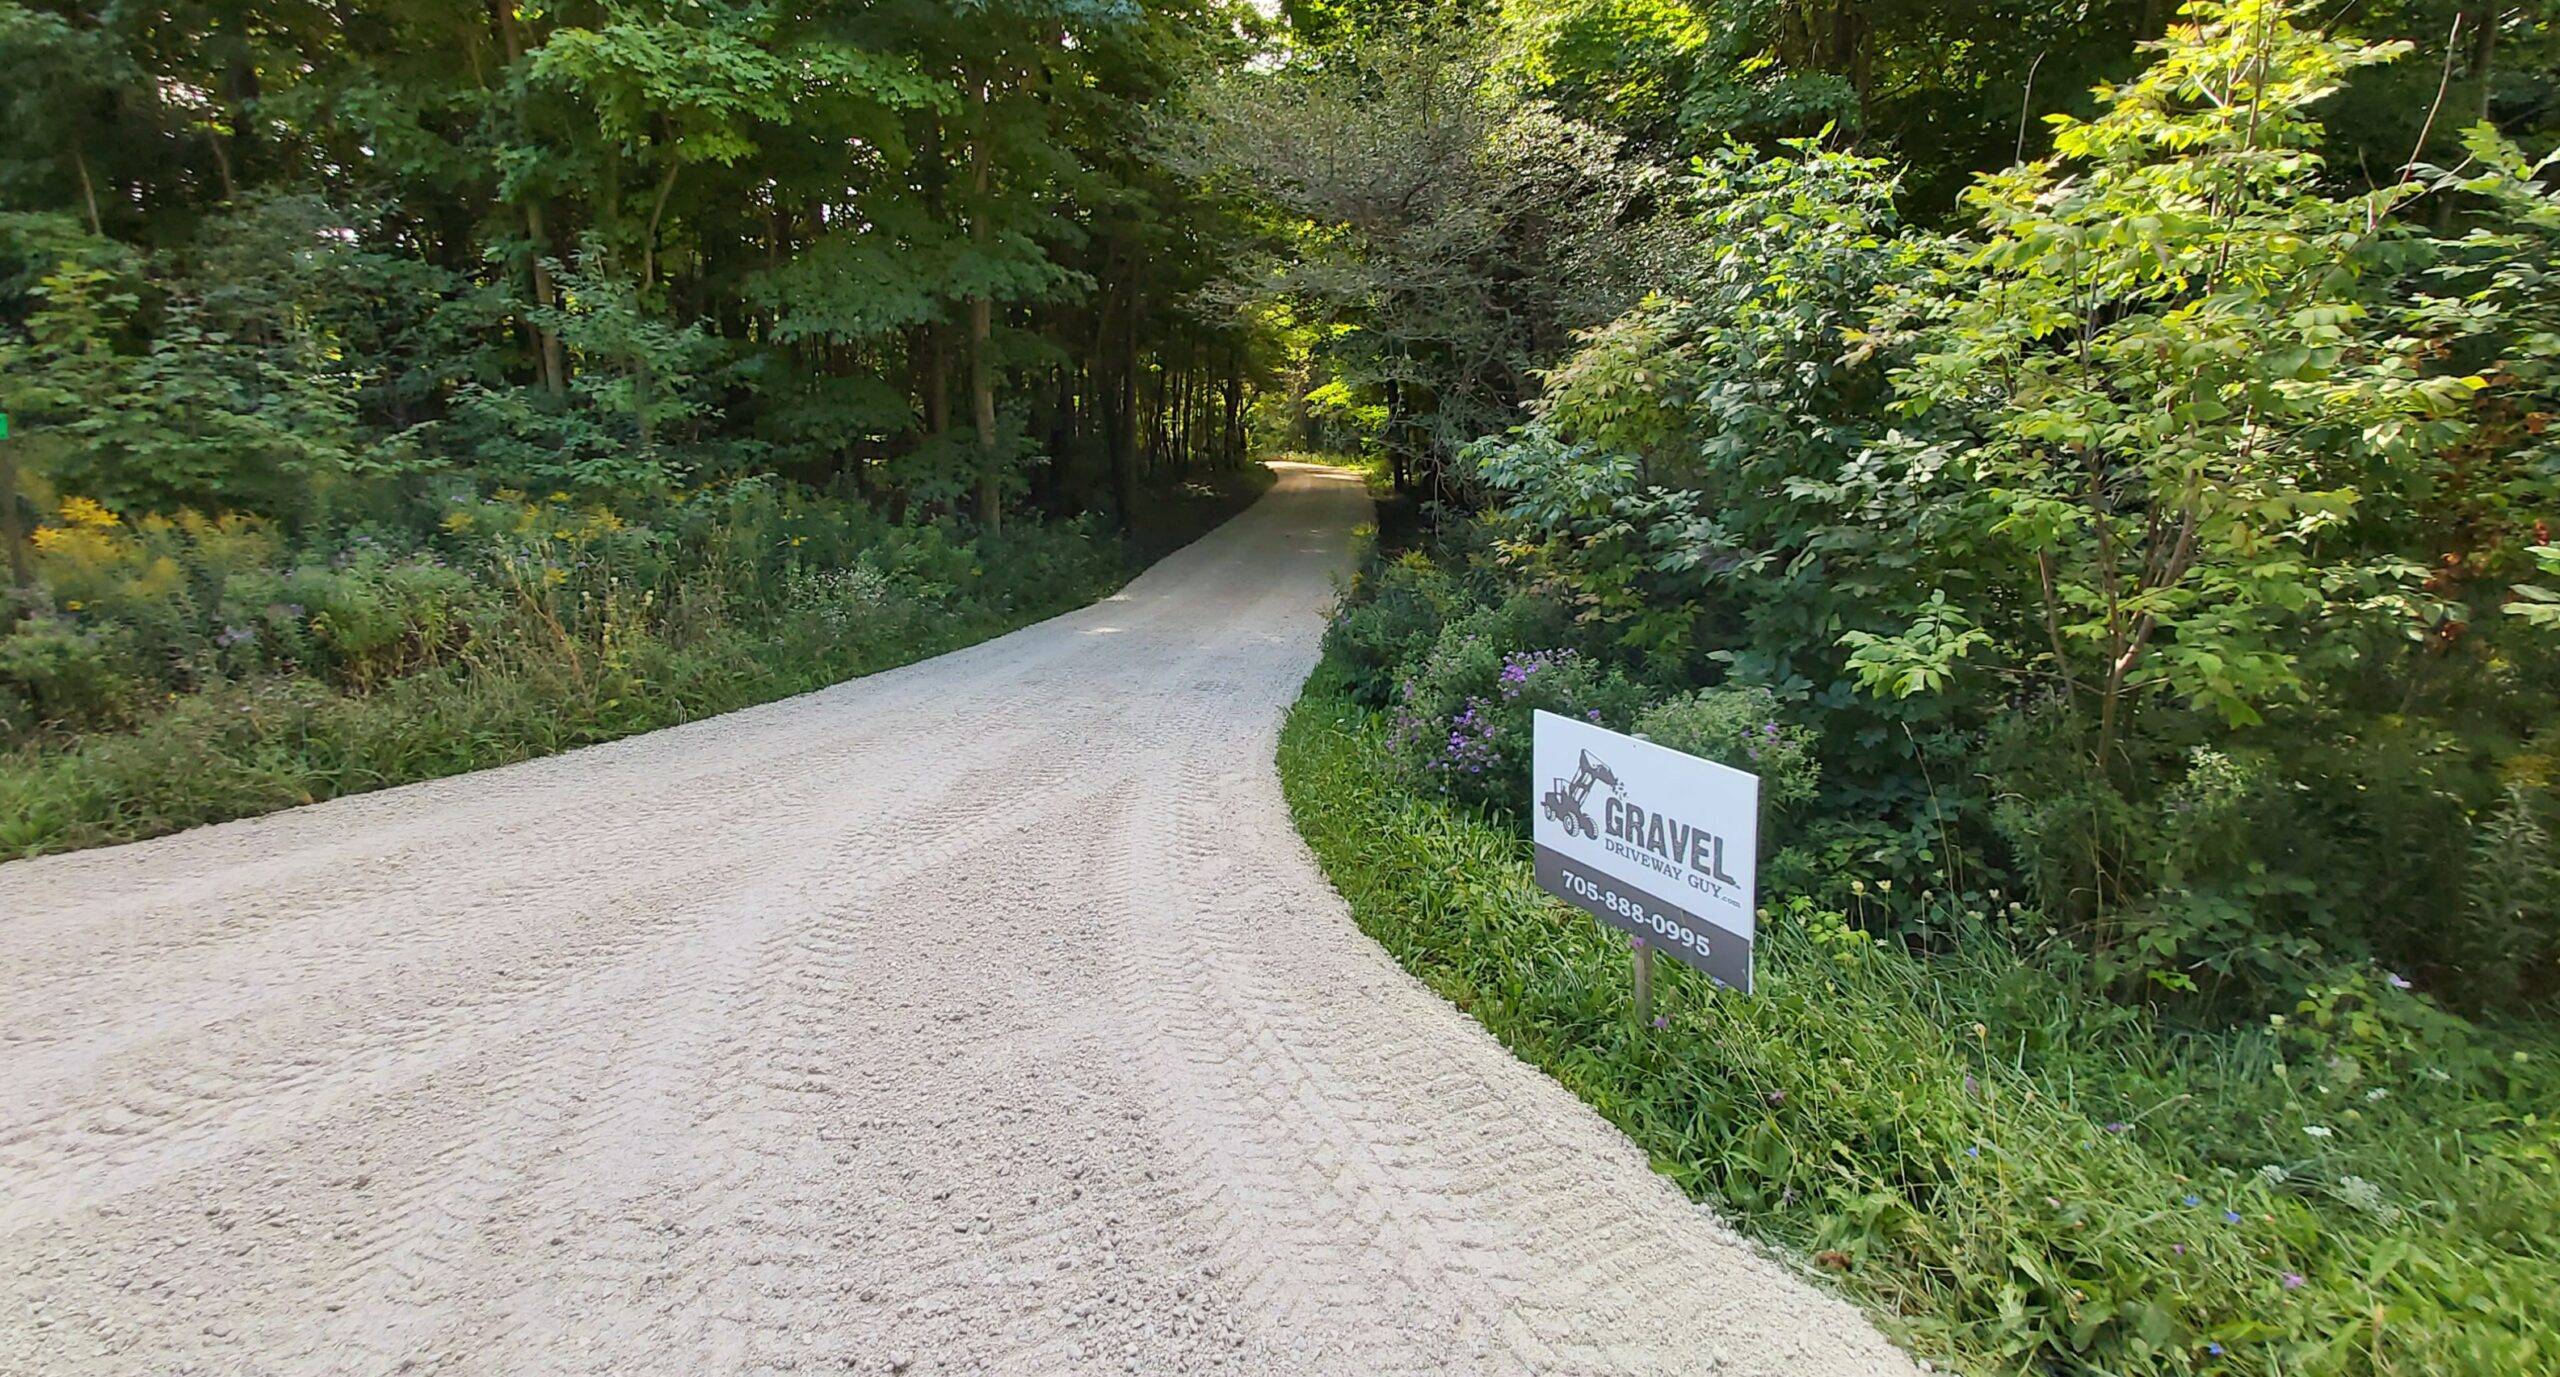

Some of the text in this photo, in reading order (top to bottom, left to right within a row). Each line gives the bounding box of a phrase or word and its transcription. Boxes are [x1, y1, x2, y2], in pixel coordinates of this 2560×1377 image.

[1605, 797, 1737, 886] GRAVEL
[1605, 837, 1683, 880] DRIVEWAY
[1562, 870, 1711, 957] 705-888-0995
